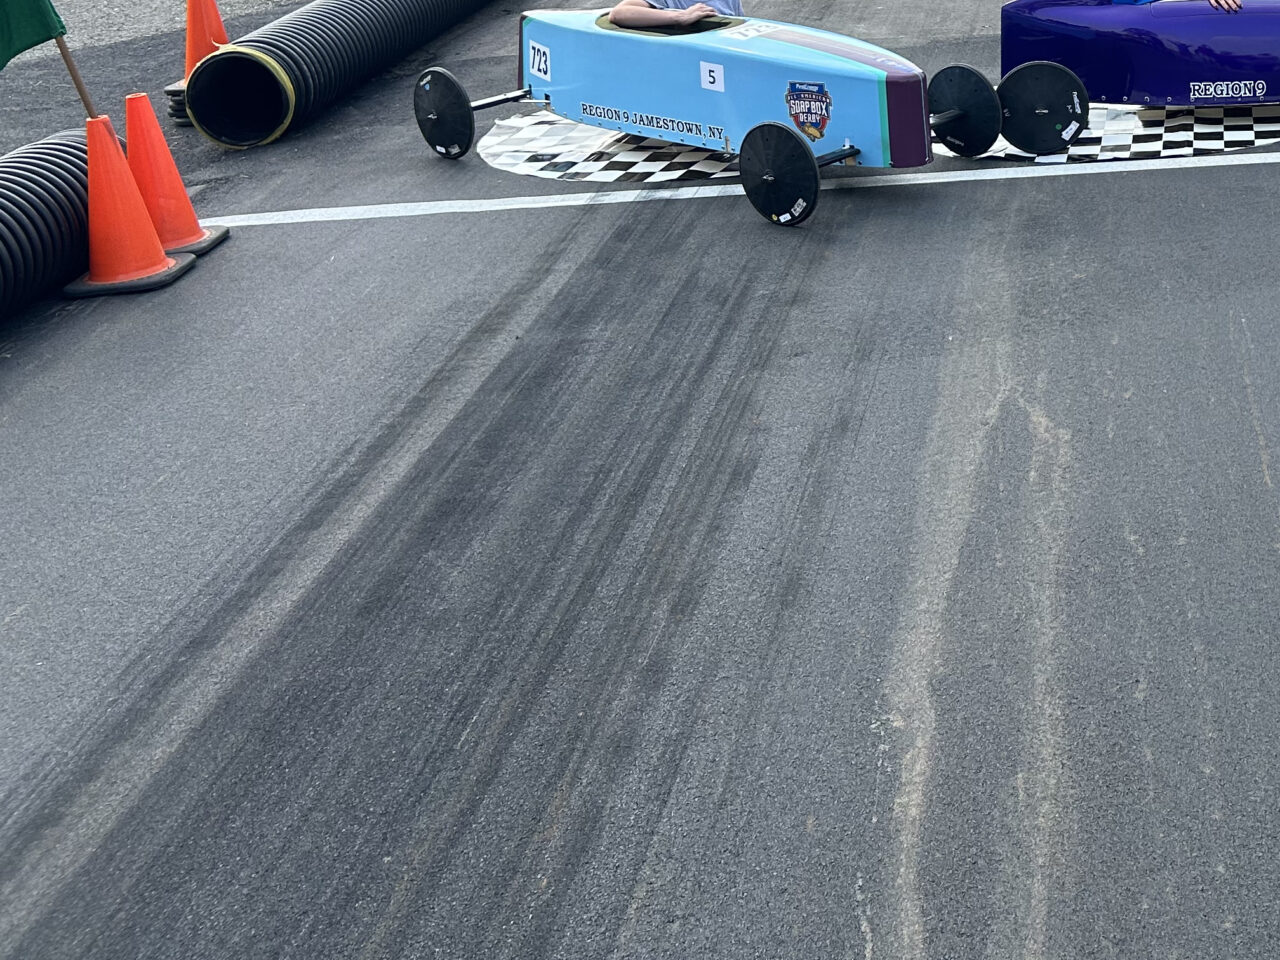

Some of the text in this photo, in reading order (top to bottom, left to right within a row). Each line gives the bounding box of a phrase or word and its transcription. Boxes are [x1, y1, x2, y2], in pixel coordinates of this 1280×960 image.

[531, 46, 549, 76] 723
[708, 69, 717, 84] 5
[1190, 80, 1266, 97] REGION 9
[790, 100, 827, 117] SOAP BOX
[581, 102, 724, 140] REGION 9 JAMESTOWN, NY
[799, 113, 821, 123] DERBY
